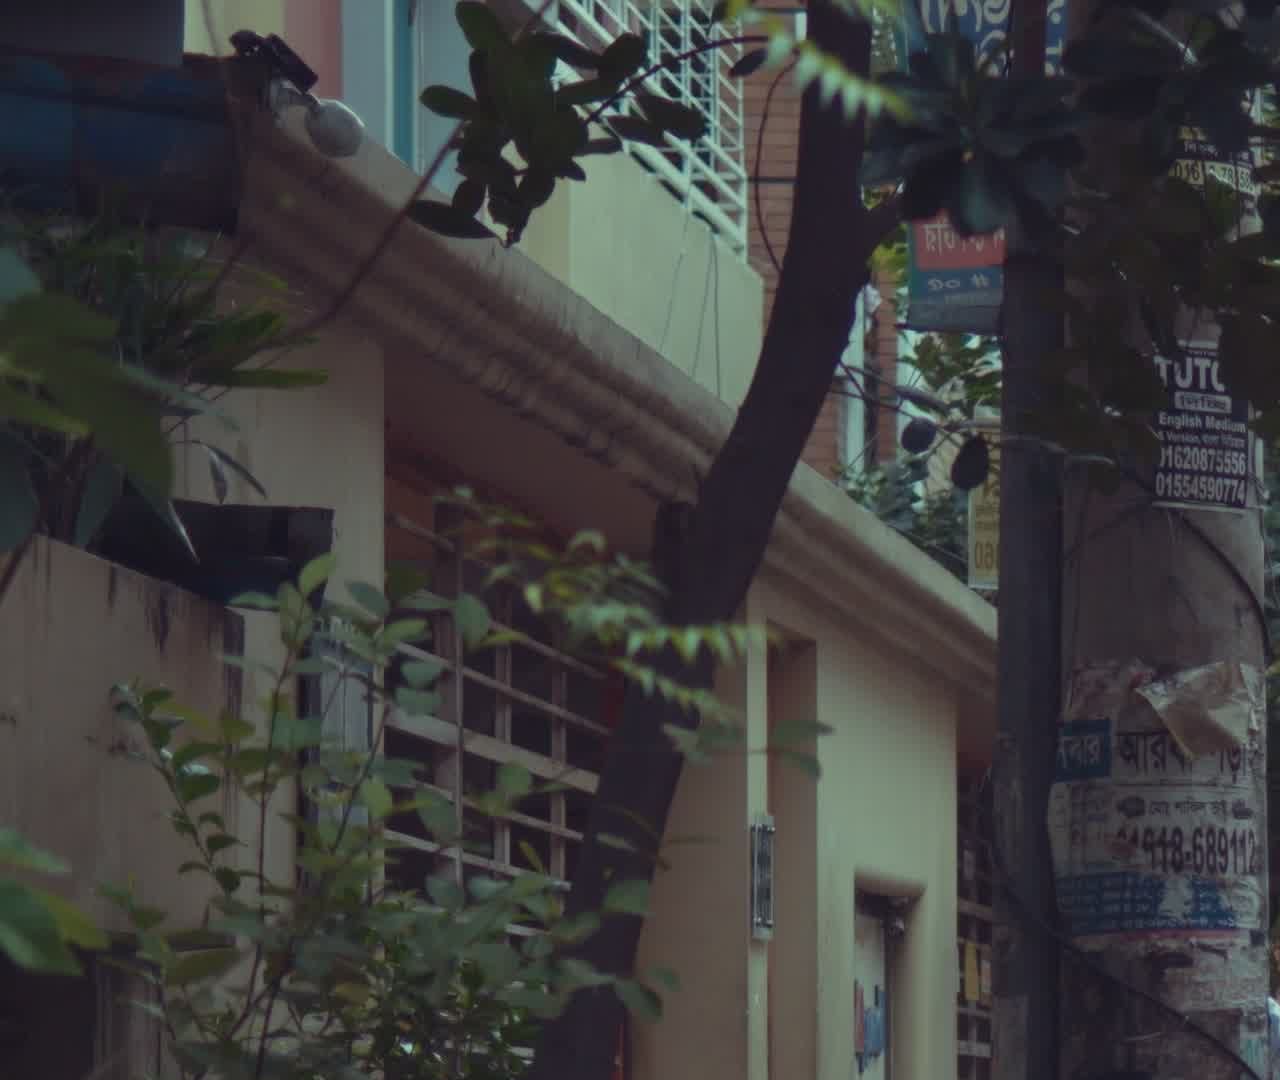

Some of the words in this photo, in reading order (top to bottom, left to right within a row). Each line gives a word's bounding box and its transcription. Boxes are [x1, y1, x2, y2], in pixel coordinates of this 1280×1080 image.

[1153, 355, 1225, 392] TUT
[1159, 411, 1202, 430] English
[1205, 416, 1246, 433] Medium
